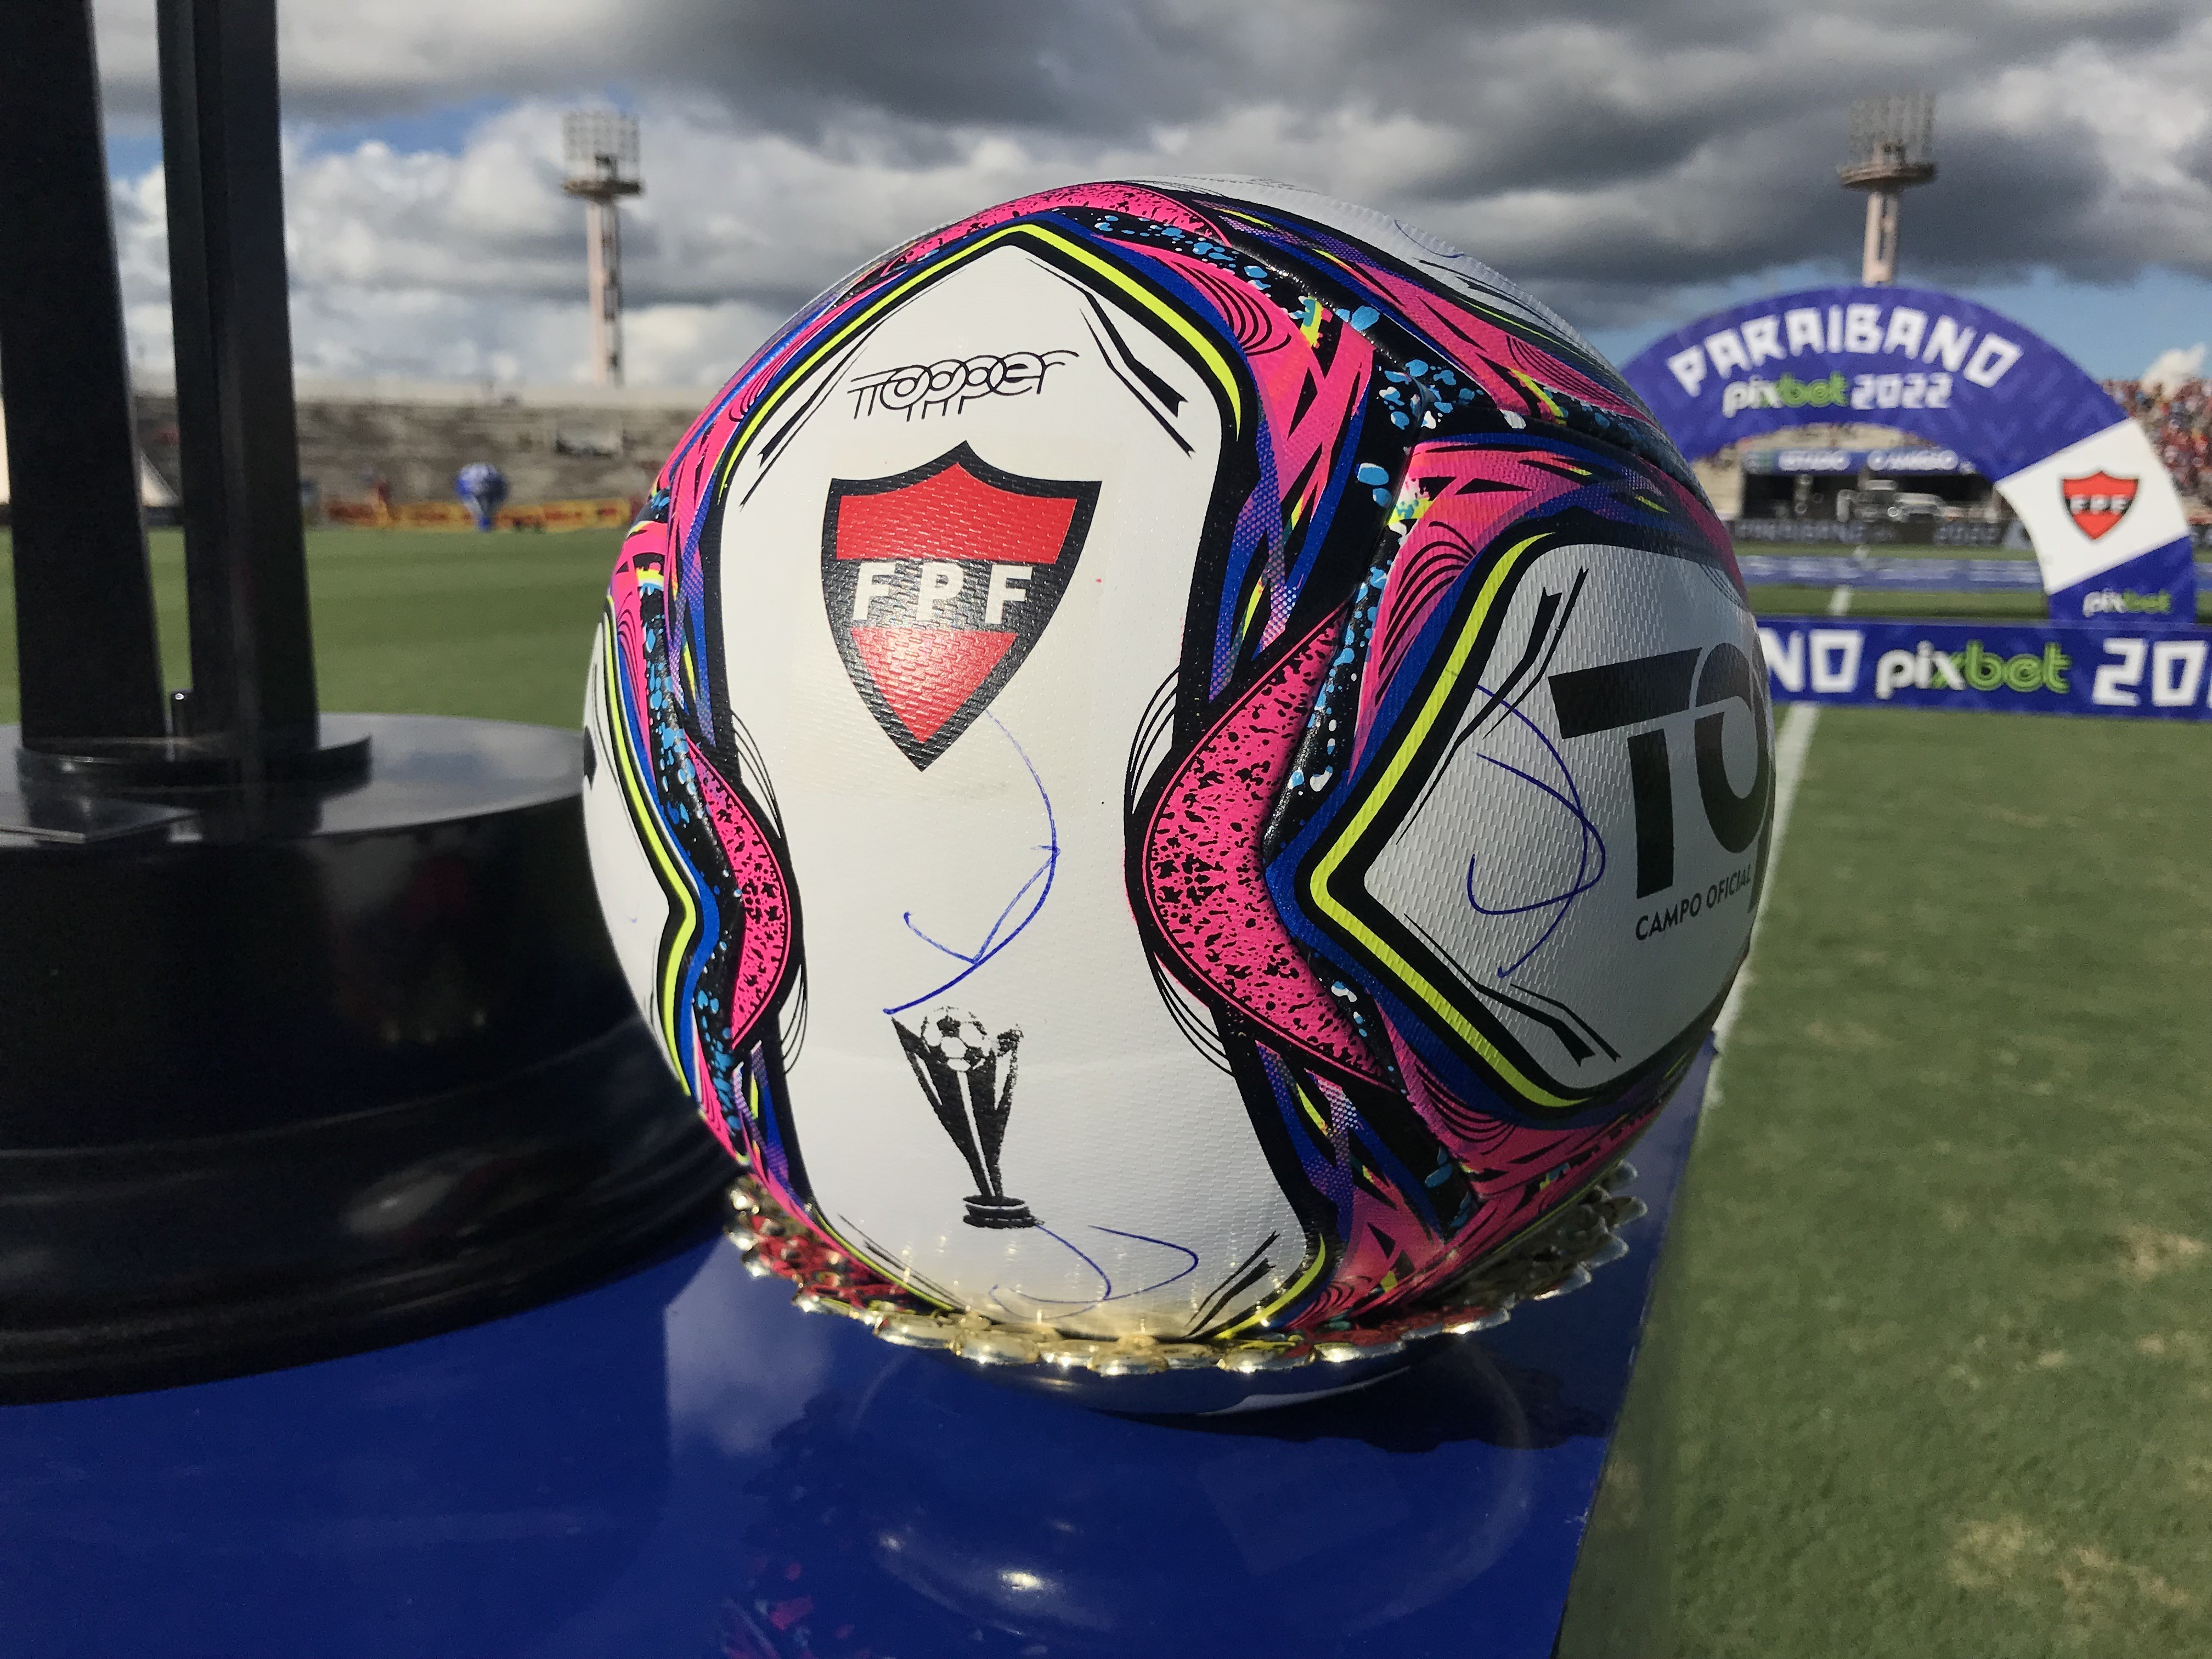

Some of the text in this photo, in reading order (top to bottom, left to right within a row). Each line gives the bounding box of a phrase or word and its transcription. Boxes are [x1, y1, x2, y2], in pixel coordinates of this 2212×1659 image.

[1667, 303, 2025, 398] PARAIBANO
[1722, 371, 1954, 419] pixbet 2022
[851, 558, 1034, 625] FPF
[2082, 588, 2172, 618] pixbet
[1875, 640, 2072, 701] pixbet
[2092, 637, 2212, 709] 20
[1548, 642, 1775, 914] TO
[1635, 862, 1752, 941] CAMPO OFICIAL
